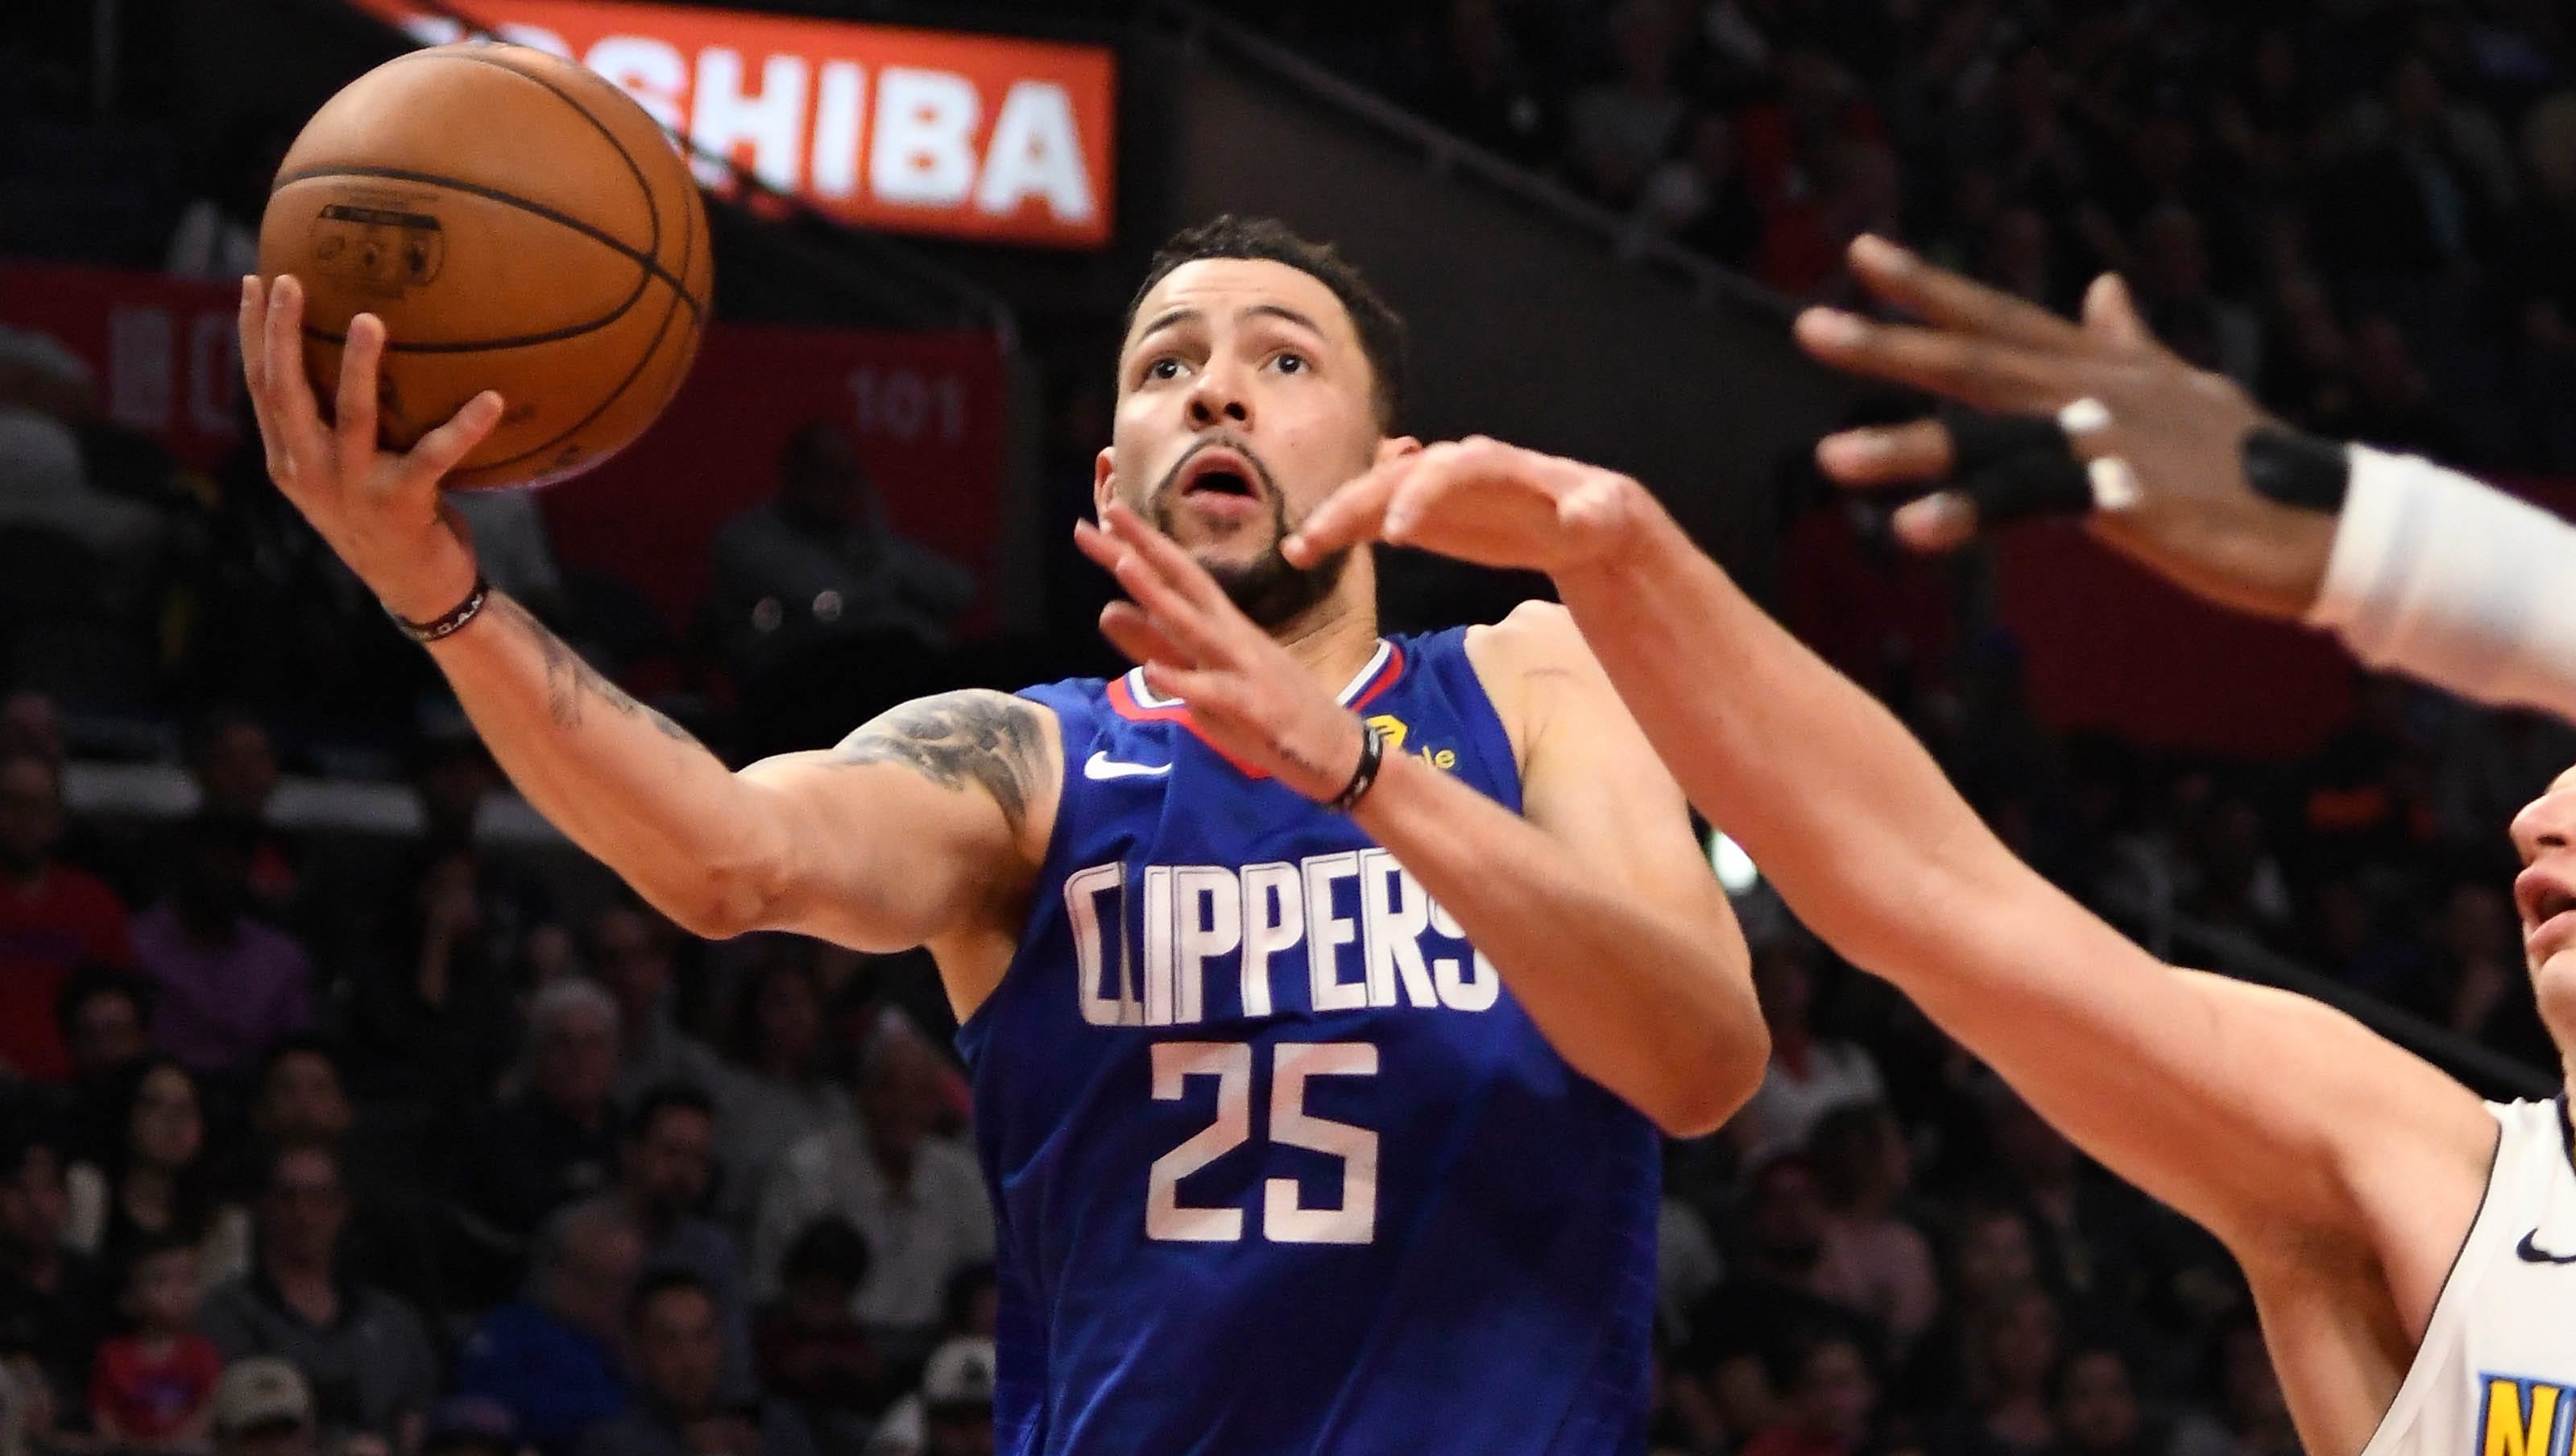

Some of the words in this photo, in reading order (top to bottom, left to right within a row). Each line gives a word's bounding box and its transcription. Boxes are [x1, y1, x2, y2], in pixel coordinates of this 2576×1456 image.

[396, 12, 1096, 225] SHIBA
[847, 367, 963, 443] 101
[1145, 1042, 1379, 1244] 25
